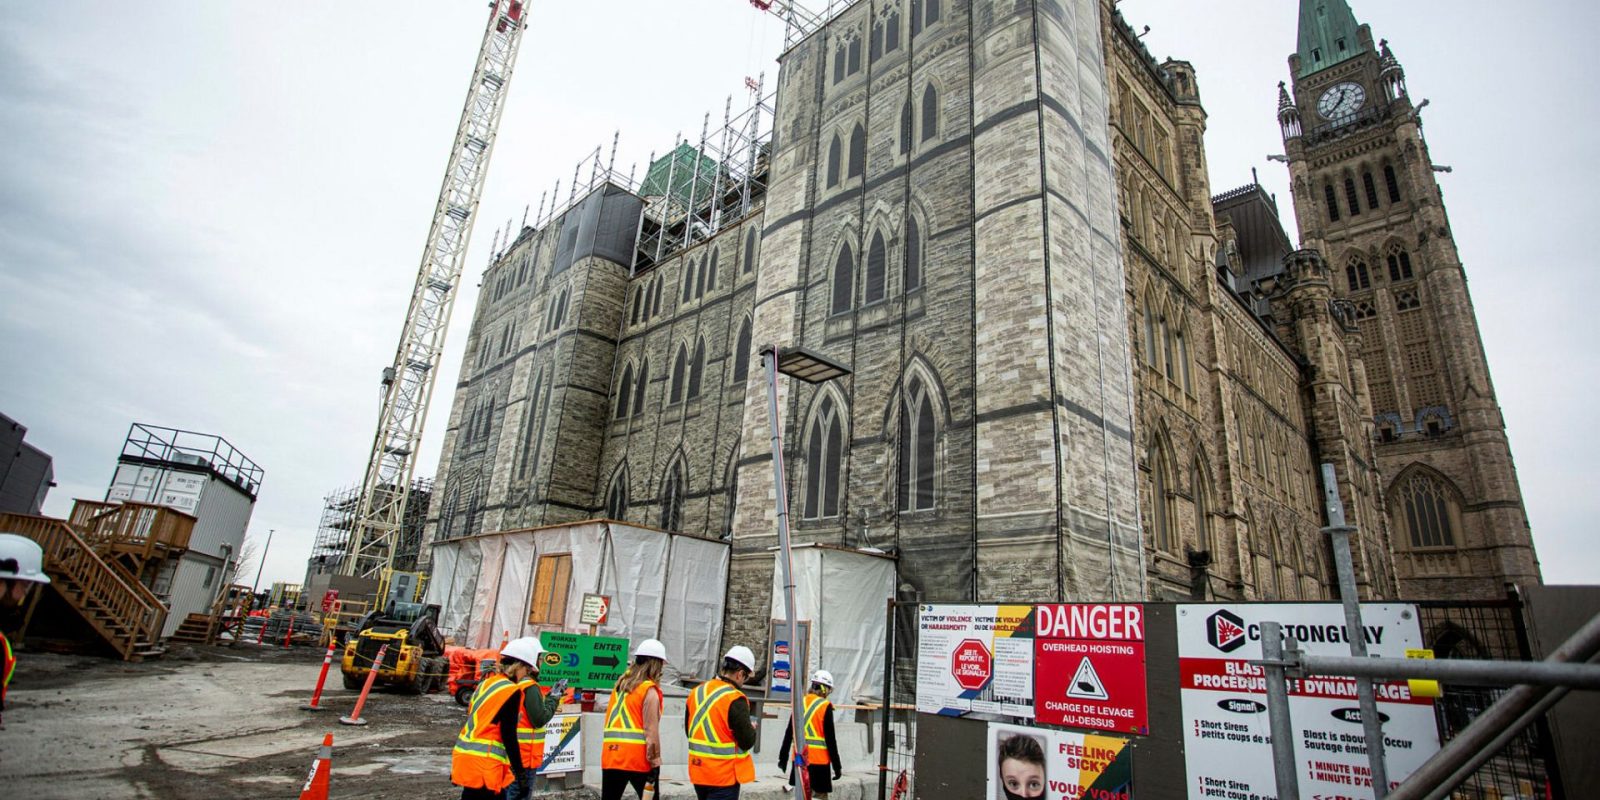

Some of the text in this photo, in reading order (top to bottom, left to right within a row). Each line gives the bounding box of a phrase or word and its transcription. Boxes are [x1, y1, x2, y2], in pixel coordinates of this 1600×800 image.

[1037, 606, 1142, 640] DANGER
[548, 642, 577, 650] PATHWAY
[594, 642, 622, 652] ENTER
[1042, 643, 1134, 654] OVERHEAD HOISTING
[1193, 674, 1267, 690] PROCEDUR
[1304, 680, 1411, 700] DYNAMAGE
[1045, 701, 1134, 718] CHARGE DE LEVAGE
[1063, 715, 1115, 728] AU-DESSUS
[1201, 720, 1222, 729] Short
[1224, 722, 1248, 732] Sirens
[1202, 730, 1225, 739] petits
[1227, 733, 1250, 743] coups
[1253, 735, 1263, 744] de
[1303, 730, 1326, 740] Blast
[1329, 732, 1337, 741] is
[1340, 733, 1366, 744] abou
[1058, 743, 1116, 762] FEELING
[1304, 740, 1342, 753] Sautage
[1068, 758, 1108, 774] SICK?
[1308, 760, 1312, 769] 1
[1315, 762, 1350, 774] MINUTE
[1199, 776, 1250, 791] 1 Short Siren
[1309, 772, 1313, 780] 1
[1317, 772, 1351, 785] MINUTE
[1049, 780, 1086, 797] VOUS
[1206, 787, 1226, 798] petit
[1228, 790, 1247, 800] coup
